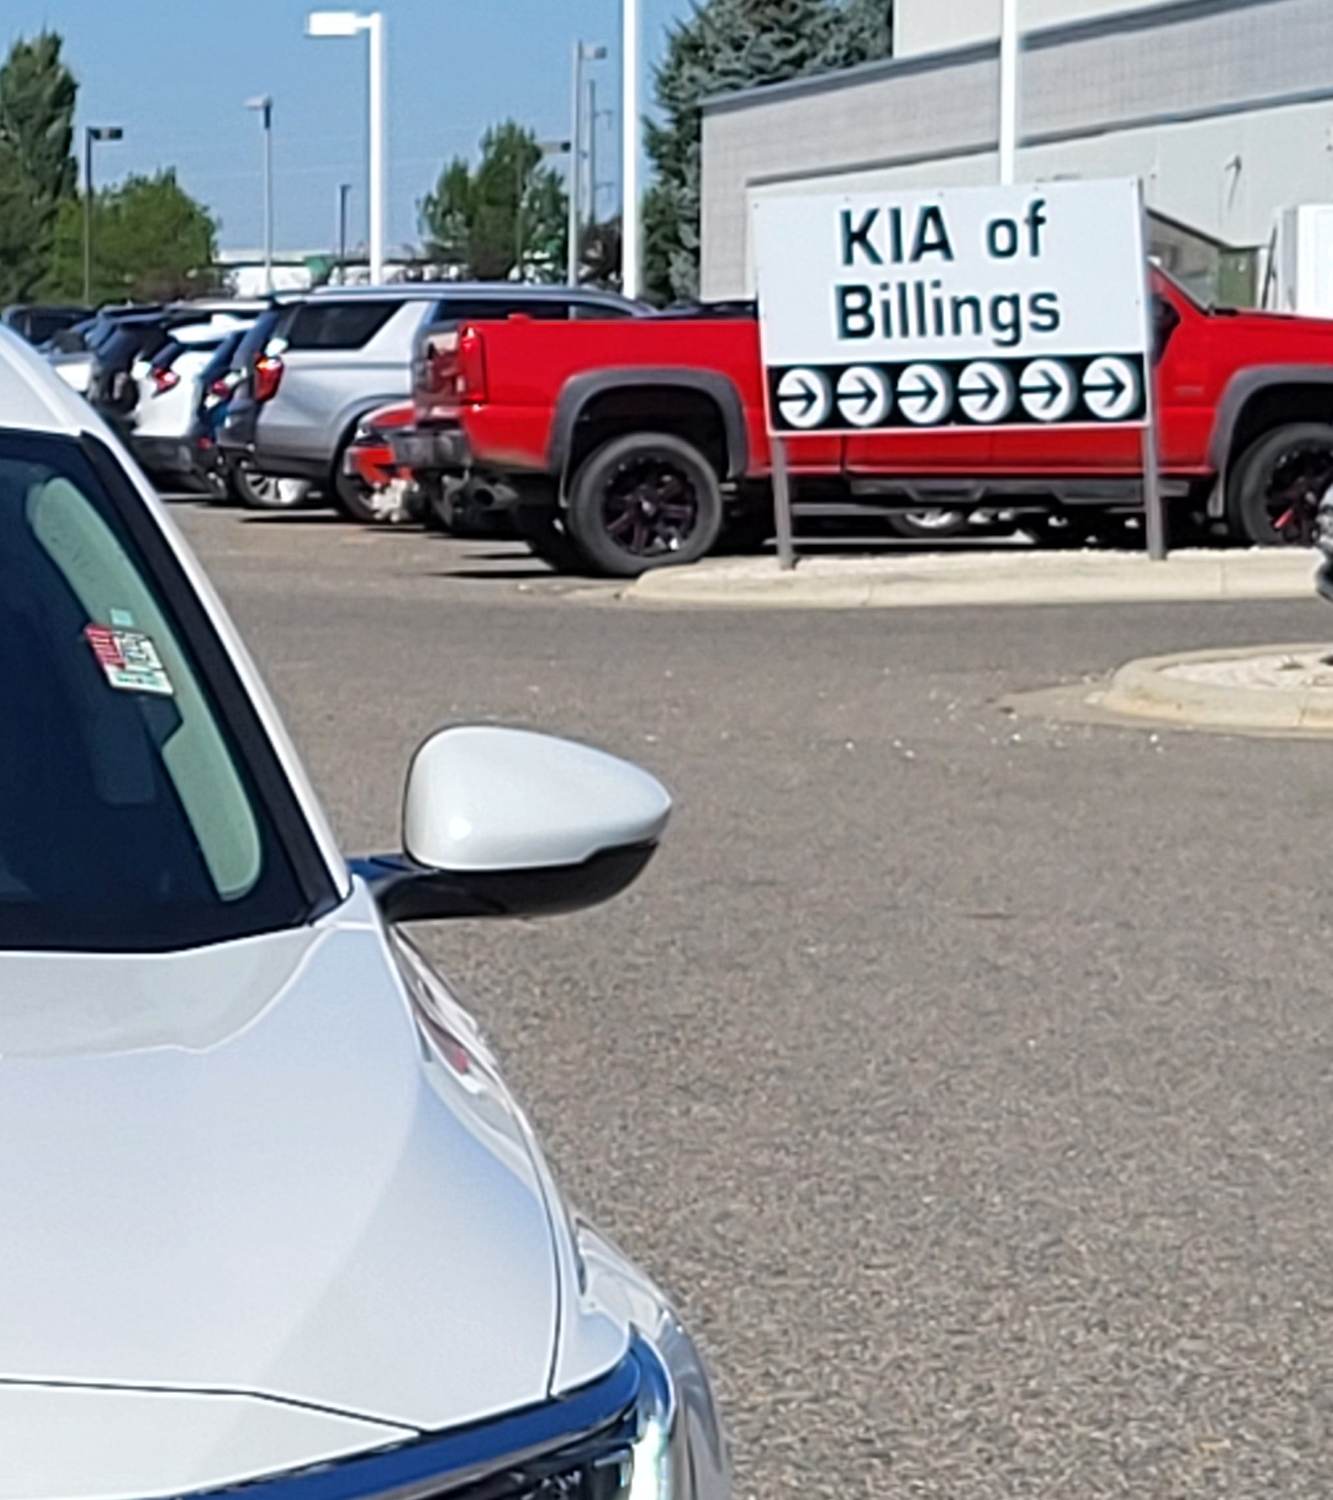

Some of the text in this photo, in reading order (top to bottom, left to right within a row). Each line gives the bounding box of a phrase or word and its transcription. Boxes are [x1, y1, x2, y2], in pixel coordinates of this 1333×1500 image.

[839, 199, 1047, 266] KIA of
[834, 280, 1061, 347] Billings
